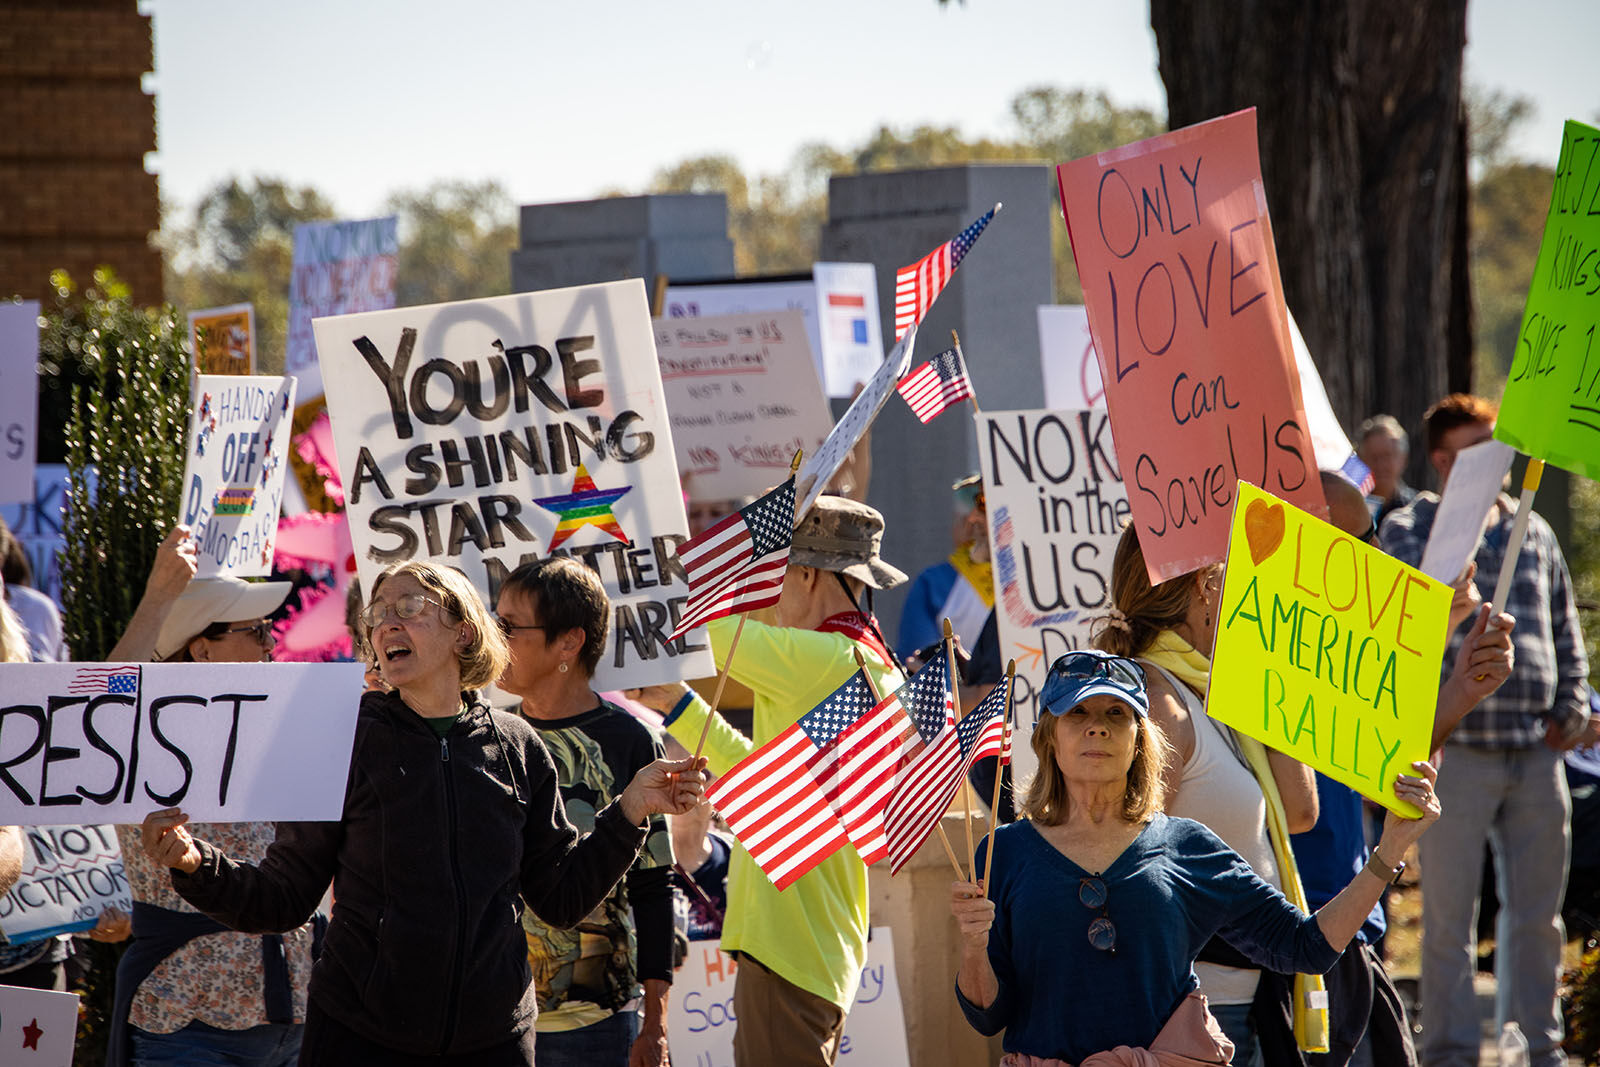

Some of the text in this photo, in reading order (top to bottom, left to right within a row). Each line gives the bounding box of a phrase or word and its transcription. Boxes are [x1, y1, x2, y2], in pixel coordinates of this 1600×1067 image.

[1098, 157, 1202, 259] ONLY
[1108, 219, 1267, 384] LOVE
[1513, 312, 1567, 383] SINCE
[219, 387, 276, 427] HANDS
[222, 432, 260, 484] OFF
[350, 410, 656, 505] A SHINING
[987, 410, 1124, 487] NO K
[365, 493, 538, 567] STAR
[1038, 477, 1132, 535] in the
[482, 534, 690, 613] MTTER
[1294, 523, 1430, 658] LOVE
[614, 596, 707, 668] ARE
[1227, 575, 1400, 720] AMERICA
[0, 665, 268, 807] RESIST
[1264, 668, 1402, 793] RALLY
[27, 823, 111, 865] NOT
